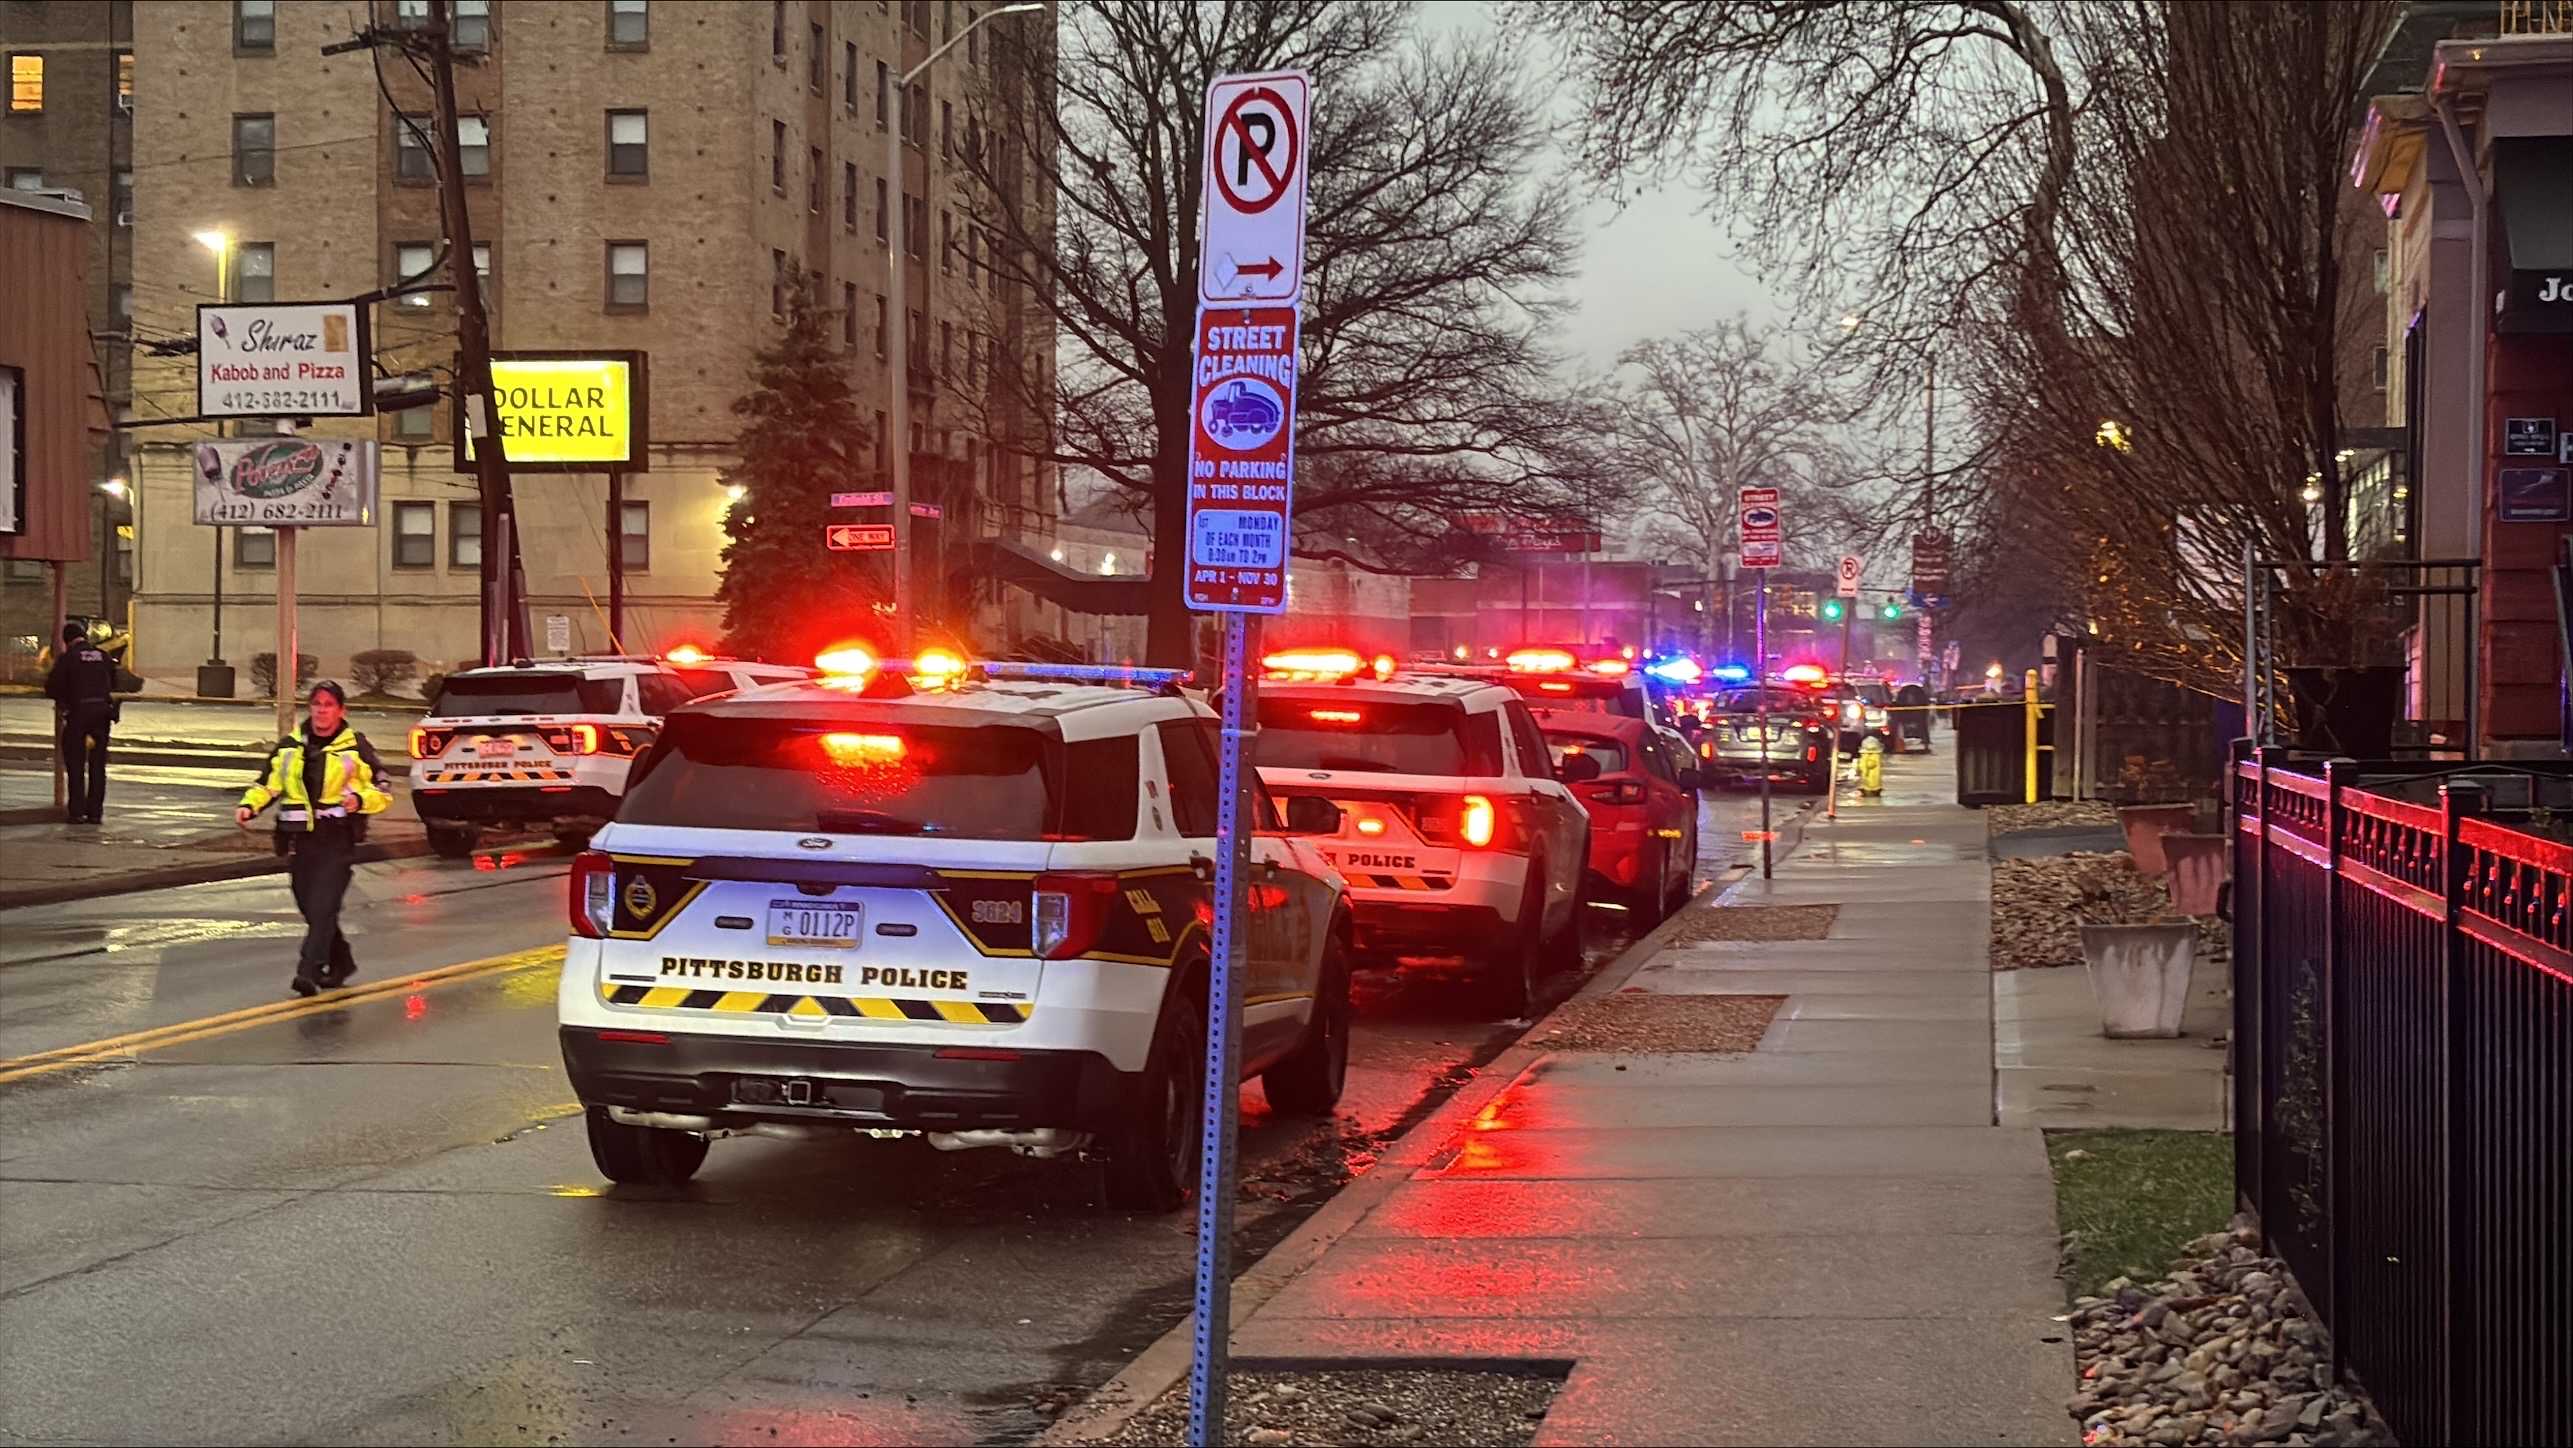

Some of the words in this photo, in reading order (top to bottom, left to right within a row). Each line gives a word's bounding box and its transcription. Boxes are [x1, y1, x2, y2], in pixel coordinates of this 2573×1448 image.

[241, 319, 318, 352] Shiraz
[1207, 325, 1286, 351] STREET
[211, 363, 259, 383] Kabob
[263, 362, 290, 380] and
[298, 362, 345, 379] Pizza
[1199, 354, 1291, 389] CLEANING
[494, 387, 605, 409] DOLLAR
[500, 415, 614, 437] ENERAL
[1194, 460, 1216, 478] NO
[1219, 460, 1286, 480] PARKING
[1194, 484, 1206, 499] IN
[1210, 484, 1238, 499] THIS
[1242, 484, 1285, 501] BLOCK
[210, 502, 255, 522] (412)
[263, 504, 343, 519] 682-2111
[1238, 516, 1279, 531] MONDAY
[1206, 531, 1215, 546] OF
[1218, 531, 1240, 546] EACH
[1242, 533, 1271, 548] MONTH
[1240, 549, 1250, 563] TO
[1194, 569, 1217, 583] APR
[1219, 570, 1226, 584] 1
[1237, 571, 1261, 585] NOV
[1263, 573, 1278, 586] 30
[1348, 853, 1416, 868] POLICE
[782, 926, 792, 936] G
[800, 911, 855, 937] 0112P
[660, 956, 844, 984] PITTSBURGH
[861, 966, 969, 990] POLICE
